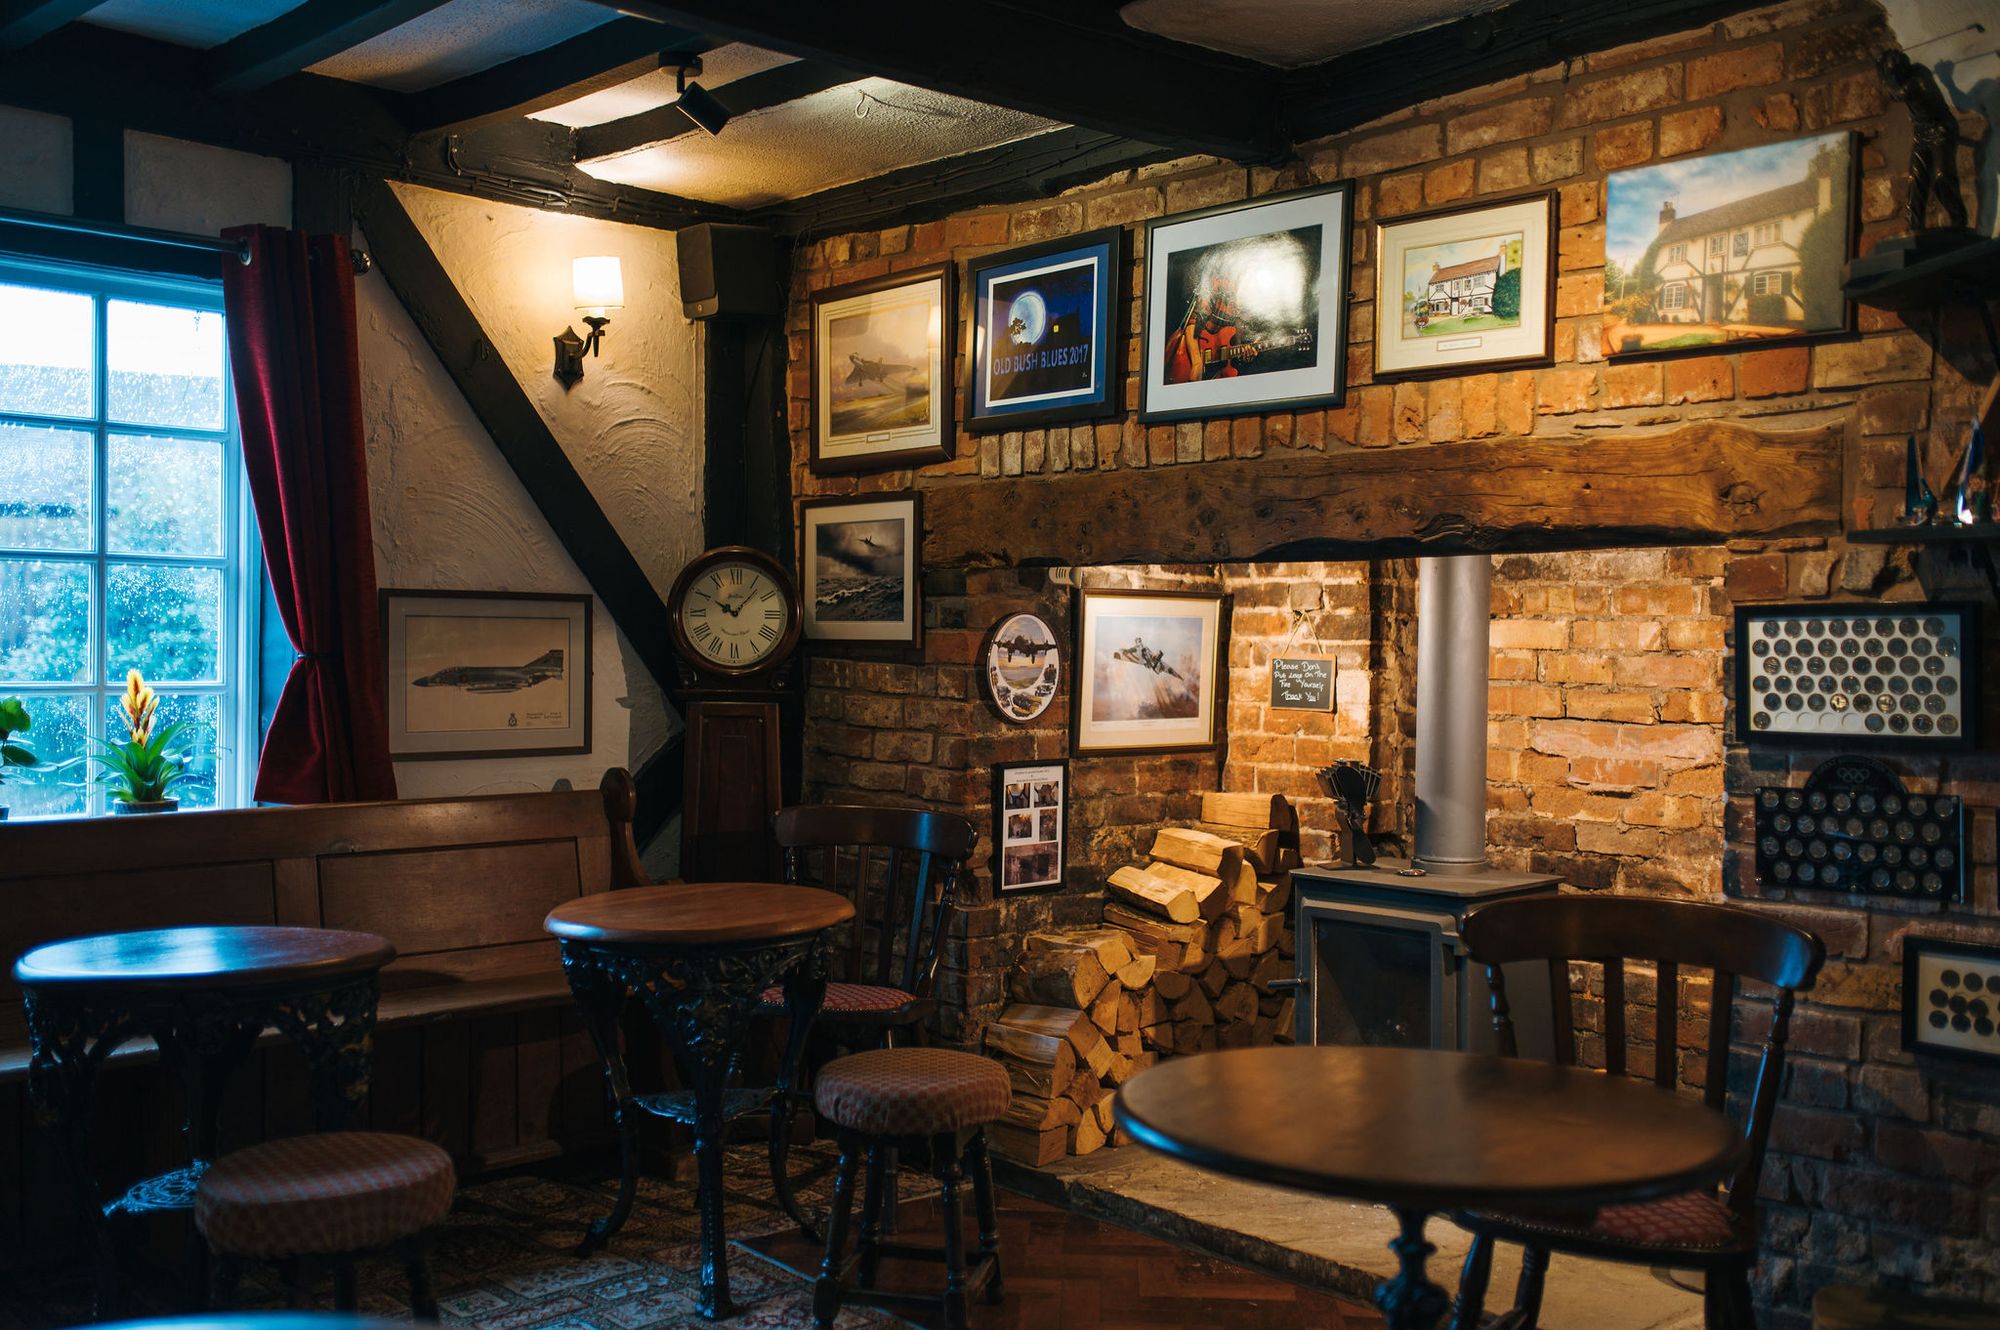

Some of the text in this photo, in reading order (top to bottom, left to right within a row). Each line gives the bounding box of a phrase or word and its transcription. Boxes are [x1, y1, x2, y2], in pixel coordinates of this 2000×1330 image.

[993, 343, 1089, 375] OLD BUSH BLUES 2017
[1273, 659, 1299, 670] Please
[1274, 671, 1286, 679] Put
[1297, 679, 1324, 692] Yourself
[1281, 690, 1303, 701] Thank
